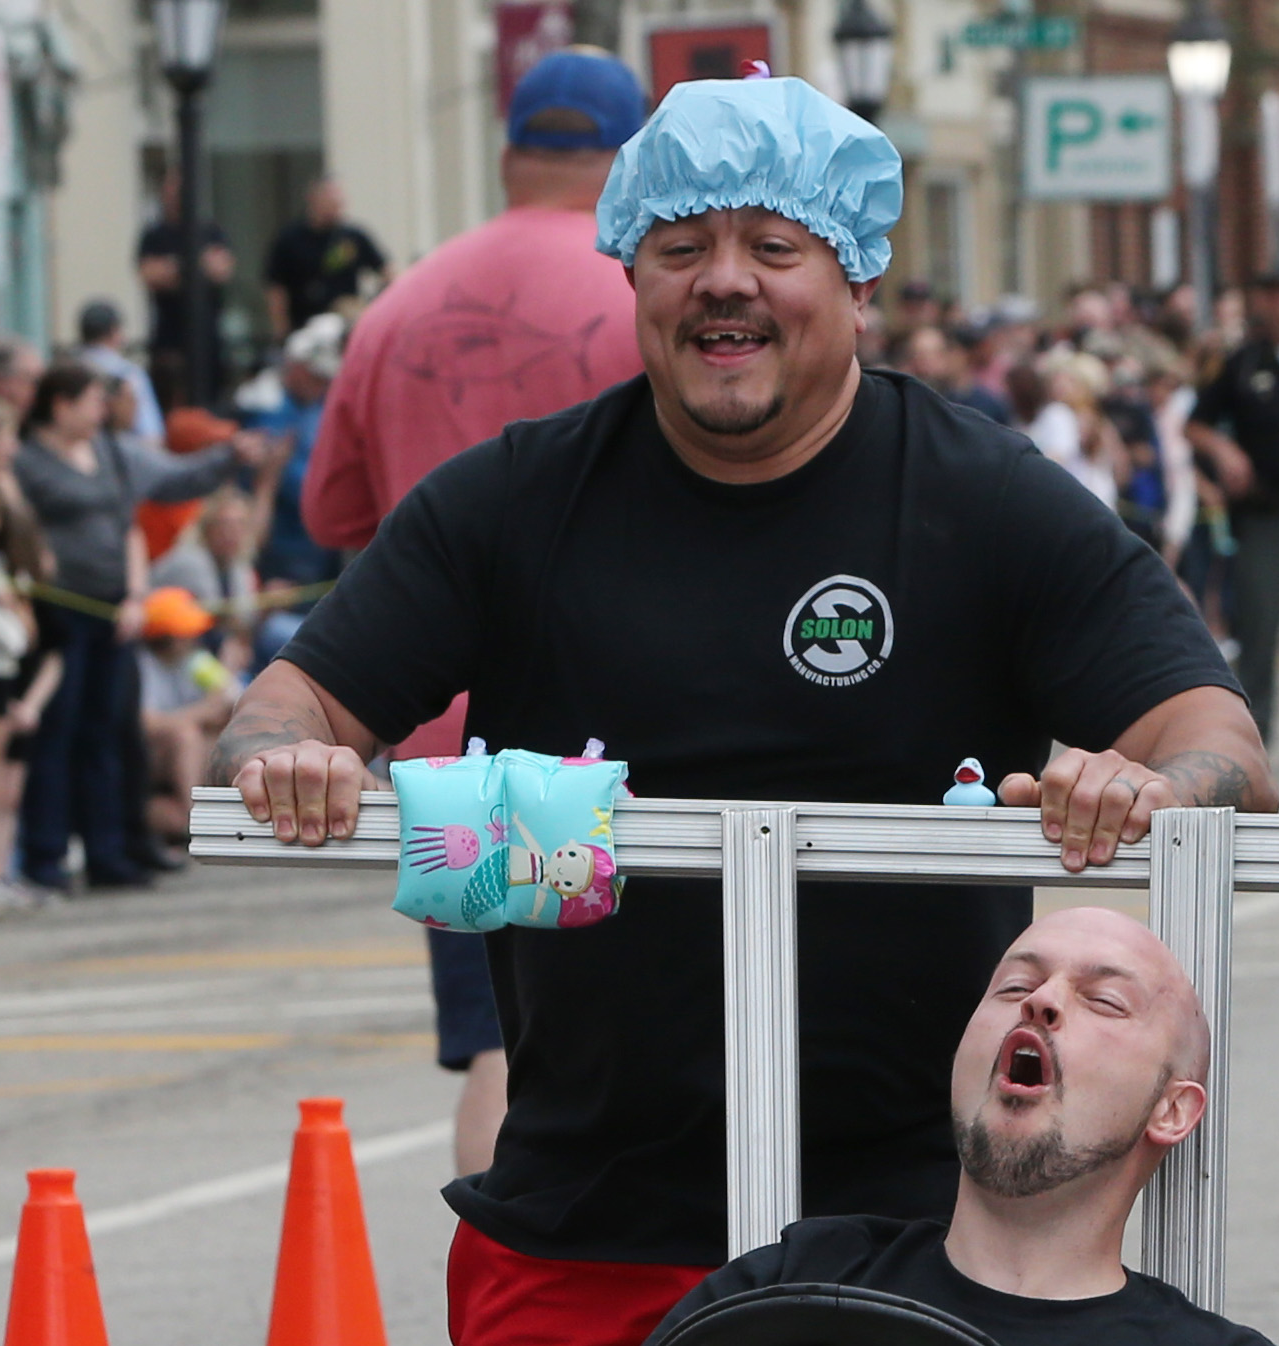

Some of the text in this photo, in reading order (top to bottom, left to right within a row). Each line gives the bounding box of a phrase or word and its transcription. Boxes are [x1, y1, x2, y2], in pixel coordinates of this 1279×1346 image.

[1045, 100, 1102, 171] P
[800, 618, 874, 640] SOLON
[788, 655, 885, 687] MANUFACTURING CO.
